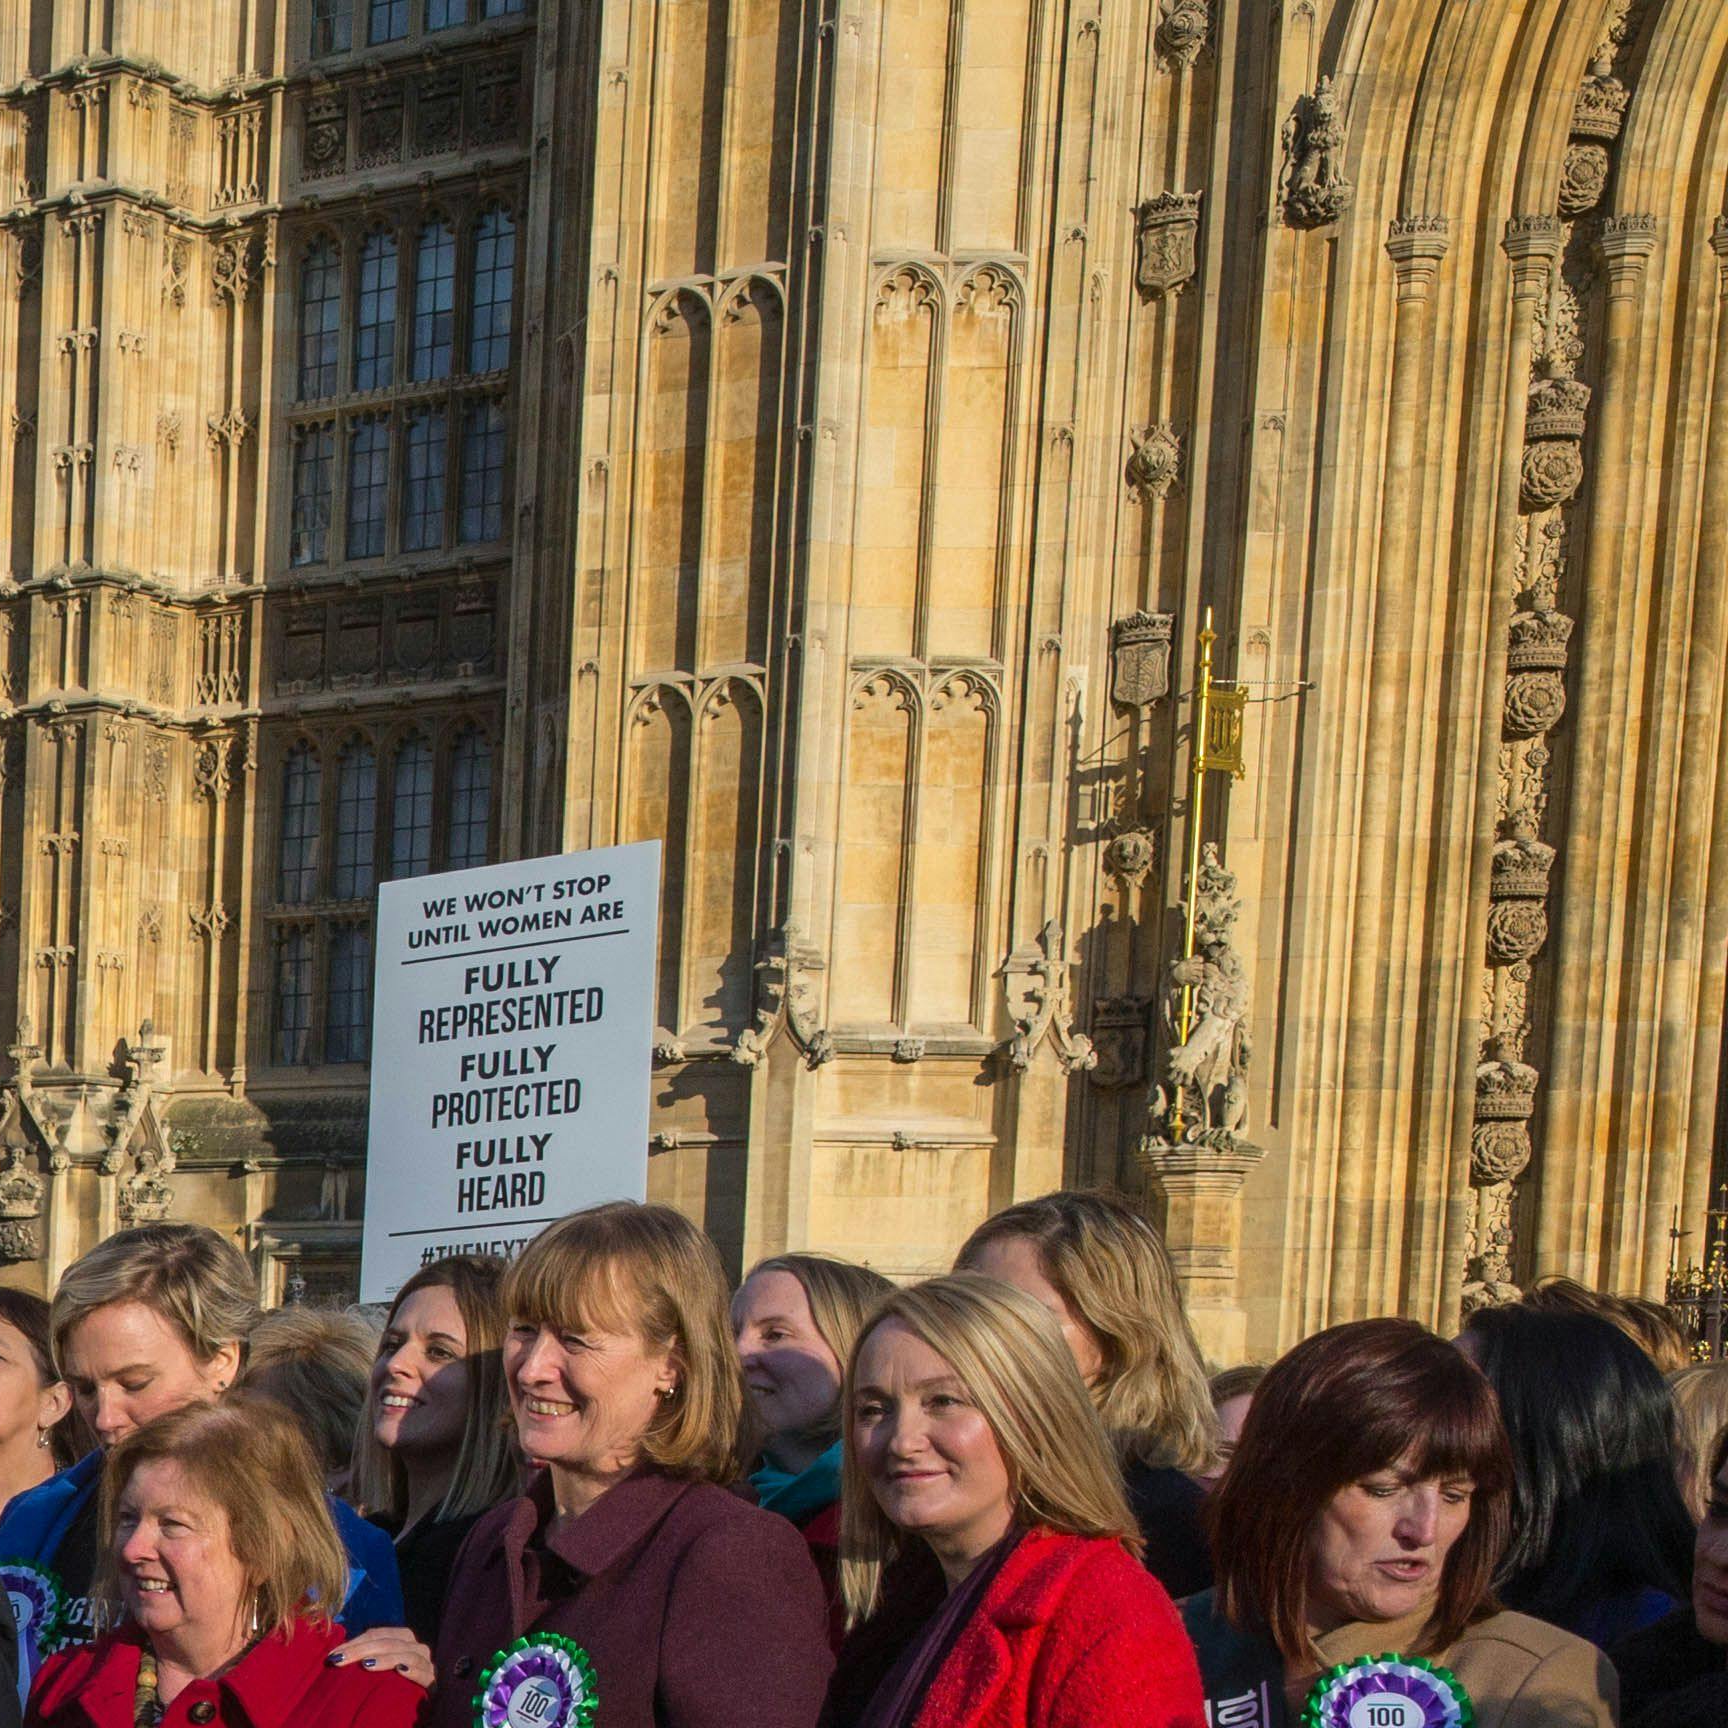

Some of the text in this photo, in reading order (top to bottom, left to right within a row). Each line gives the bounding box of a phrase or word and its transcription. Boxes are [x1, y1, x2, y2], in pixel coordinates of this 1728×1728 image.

[423, 874, 611, 918] WE WON'T STOP
[408, 900, 624, 949] UNTIL WOMEN ARE
[464, 955, 561, 995] FULLY
[419, 987, 604, 1044] REPRESENTED
[460, 1044, 557, 1082] FULLY
[431, 1078, 581, 1129] PROTECTED
[456, 1133, 553, 1170] FULLY
[457, 1170, 545, 1213] HEARD
[520, 1690, 549, 1718] 100
[1367, 1707, 1404, 1727] 100
